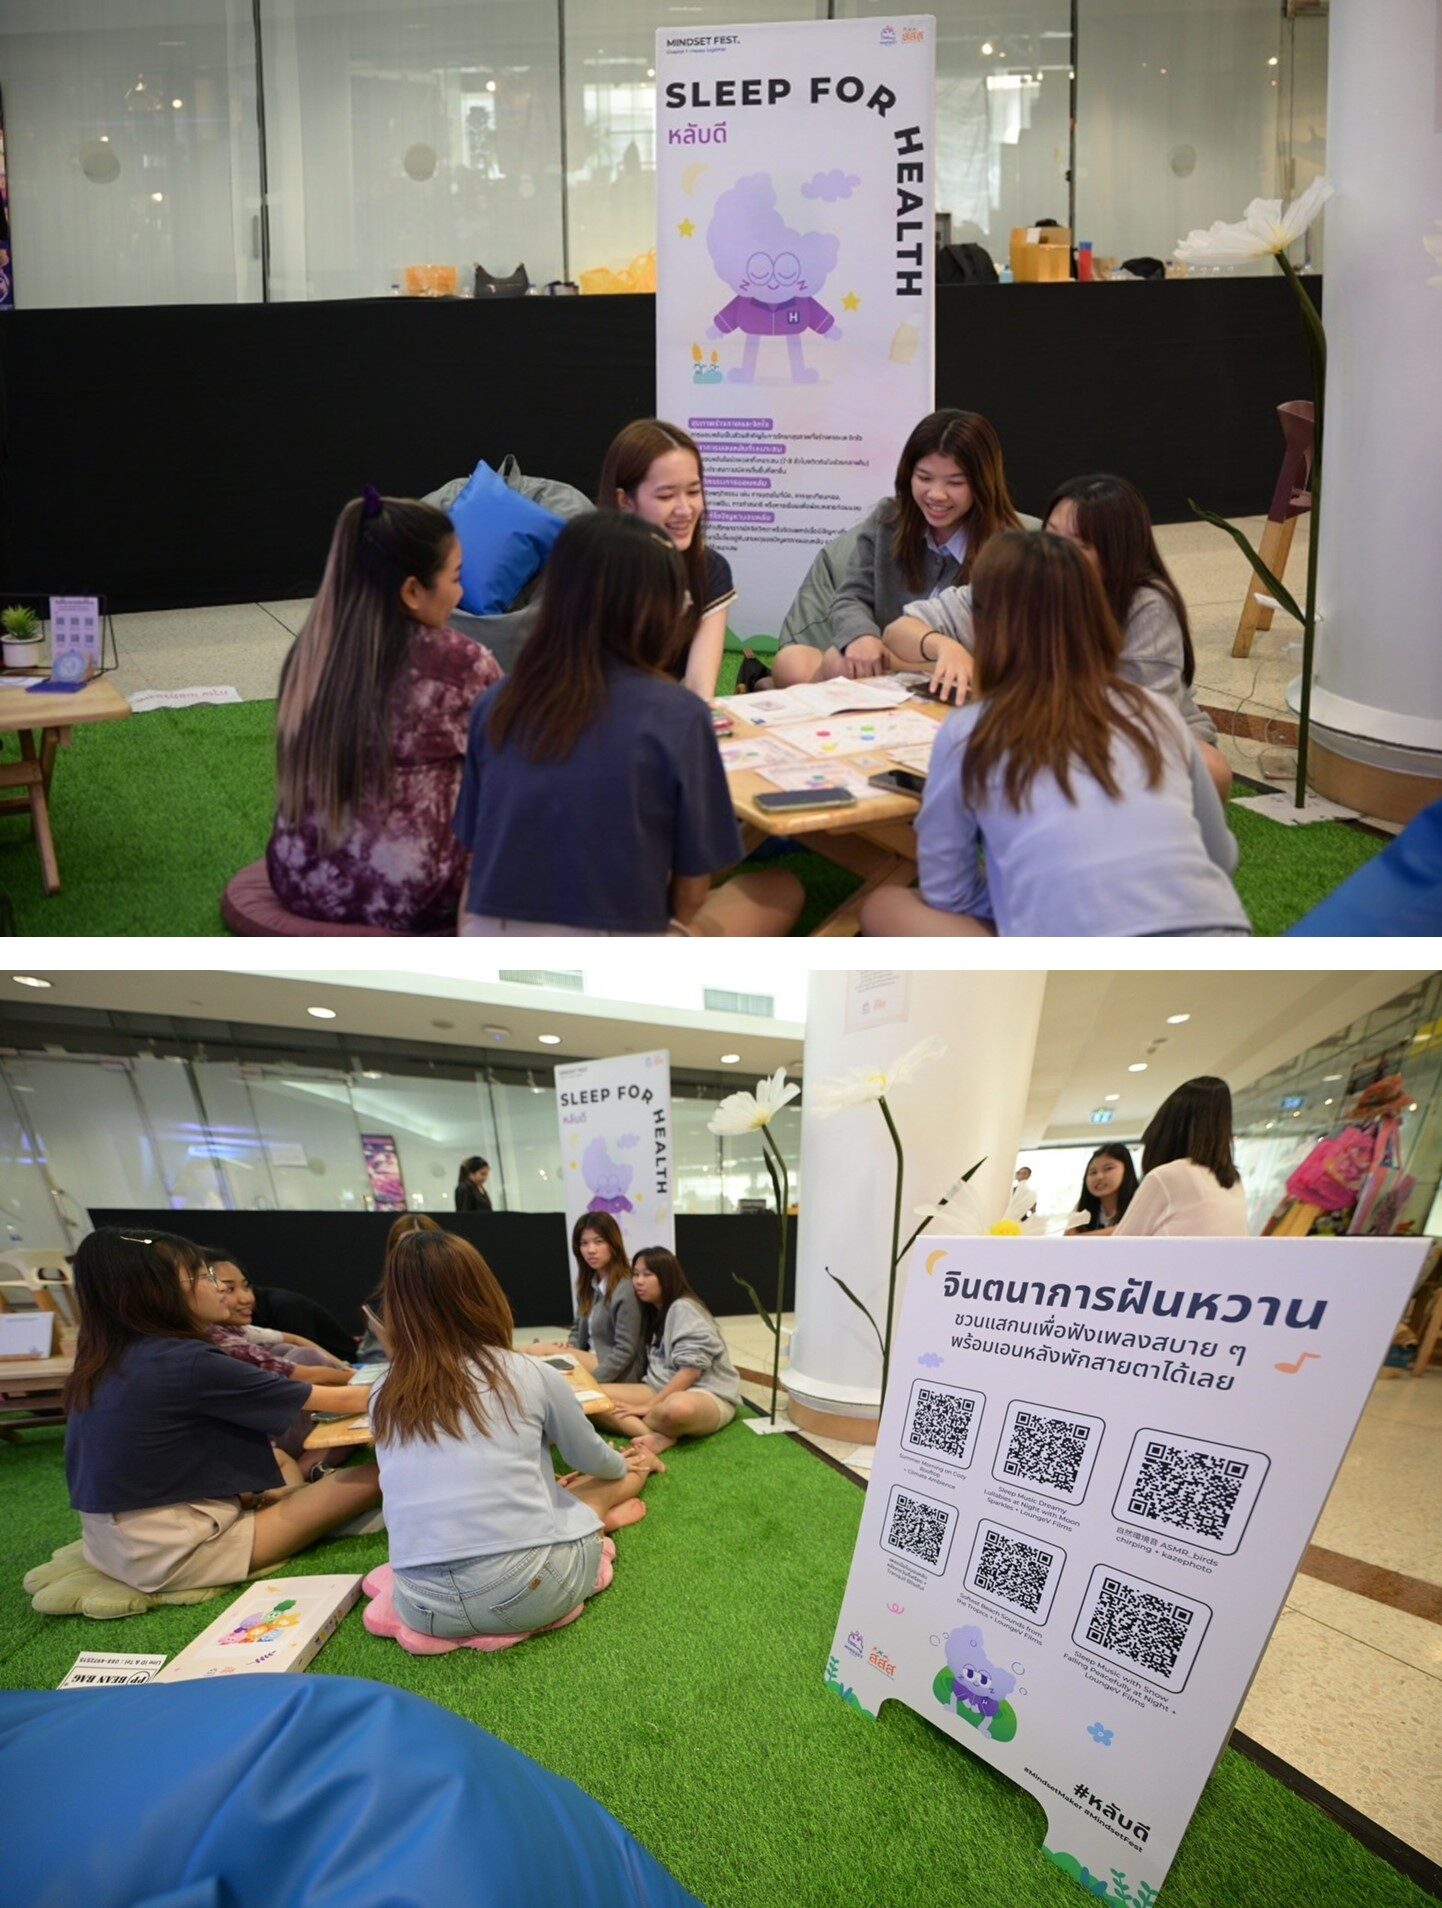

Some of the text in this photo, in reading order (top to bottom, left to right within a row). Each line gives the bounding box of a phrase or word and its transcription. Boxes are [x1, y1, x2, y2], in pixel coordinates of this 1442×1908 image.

[666, 35, 741, 47] MINDSET FEST.
[668, 121, 728, 145] หลับดี
[666, 76, 924, 296] SLEEP FOR HEALTH
[788, 312, 798, 322] H
[560, 1084, 668, 1194] SLEEP FOR HEALTH
[943, 1269, 1328, 1332] จินตนาการฝันหวาน
[954, 1310, 1248, 1368] ชวนแสกนเพื่อฟังเพลงสบาย ๆ
[950, 1331, 1236, 1392] พร้อมเอนหลังพักสายตาได้เลย
[907, 1468, 928, 1480] Climate
[928, 1476, 956, 1490] Ambience
[922, 1460, 944, 1473] Morning
[952, 1471, 967, 1480] Cozy
[984, 1488, 1012, 1503] Lullabies
[1020, 1501, 1040, 1513] Night
[1041, 1508, 1058, 1519] with
[1058, 1515, 1080, 1527] Moon
[987, 1497, 1014, 1512] Sparkles
[1052, 1520, 1073, 1533] Films
[998, 1486, 1068, 1515] Sleep Music Dreamy
[1116, 1536, 1153, 1554] chirping
[1162, 1551, 1212, 1574] kazephoto
[1159, 1542, 1219, 1567] ASMR_birds
[956, 1598, 967, 1606] the
[968, 1603, 988, 1618] Tropics
[1024, 1632, 1042, 1646] Films
[980, 1602, 1000, 1617] Beach
[1000, 1613, 1026, 1630] Sounds
[1026, 1626, 1043, 1638] from
[71, 1674, 147, 1684] PP BEAN BAG
[1063, 1652, 1089, 1671] Falling
[1090, 1667, 1132, 1693] Peacefully
[1132, 1690, 1142, 1698] at
[1143, 1694, 1170, 1712] Night
[1074, 1650, 1169, 1702] Sleep Music with Snow
[1084, 1672, 1146, 1708] LoungeV Films
[1024, 1766, 1143, 1853] #MindsetMaker #MindsetFest
[1073, 1784, 1150, 1843] #หลับดี
